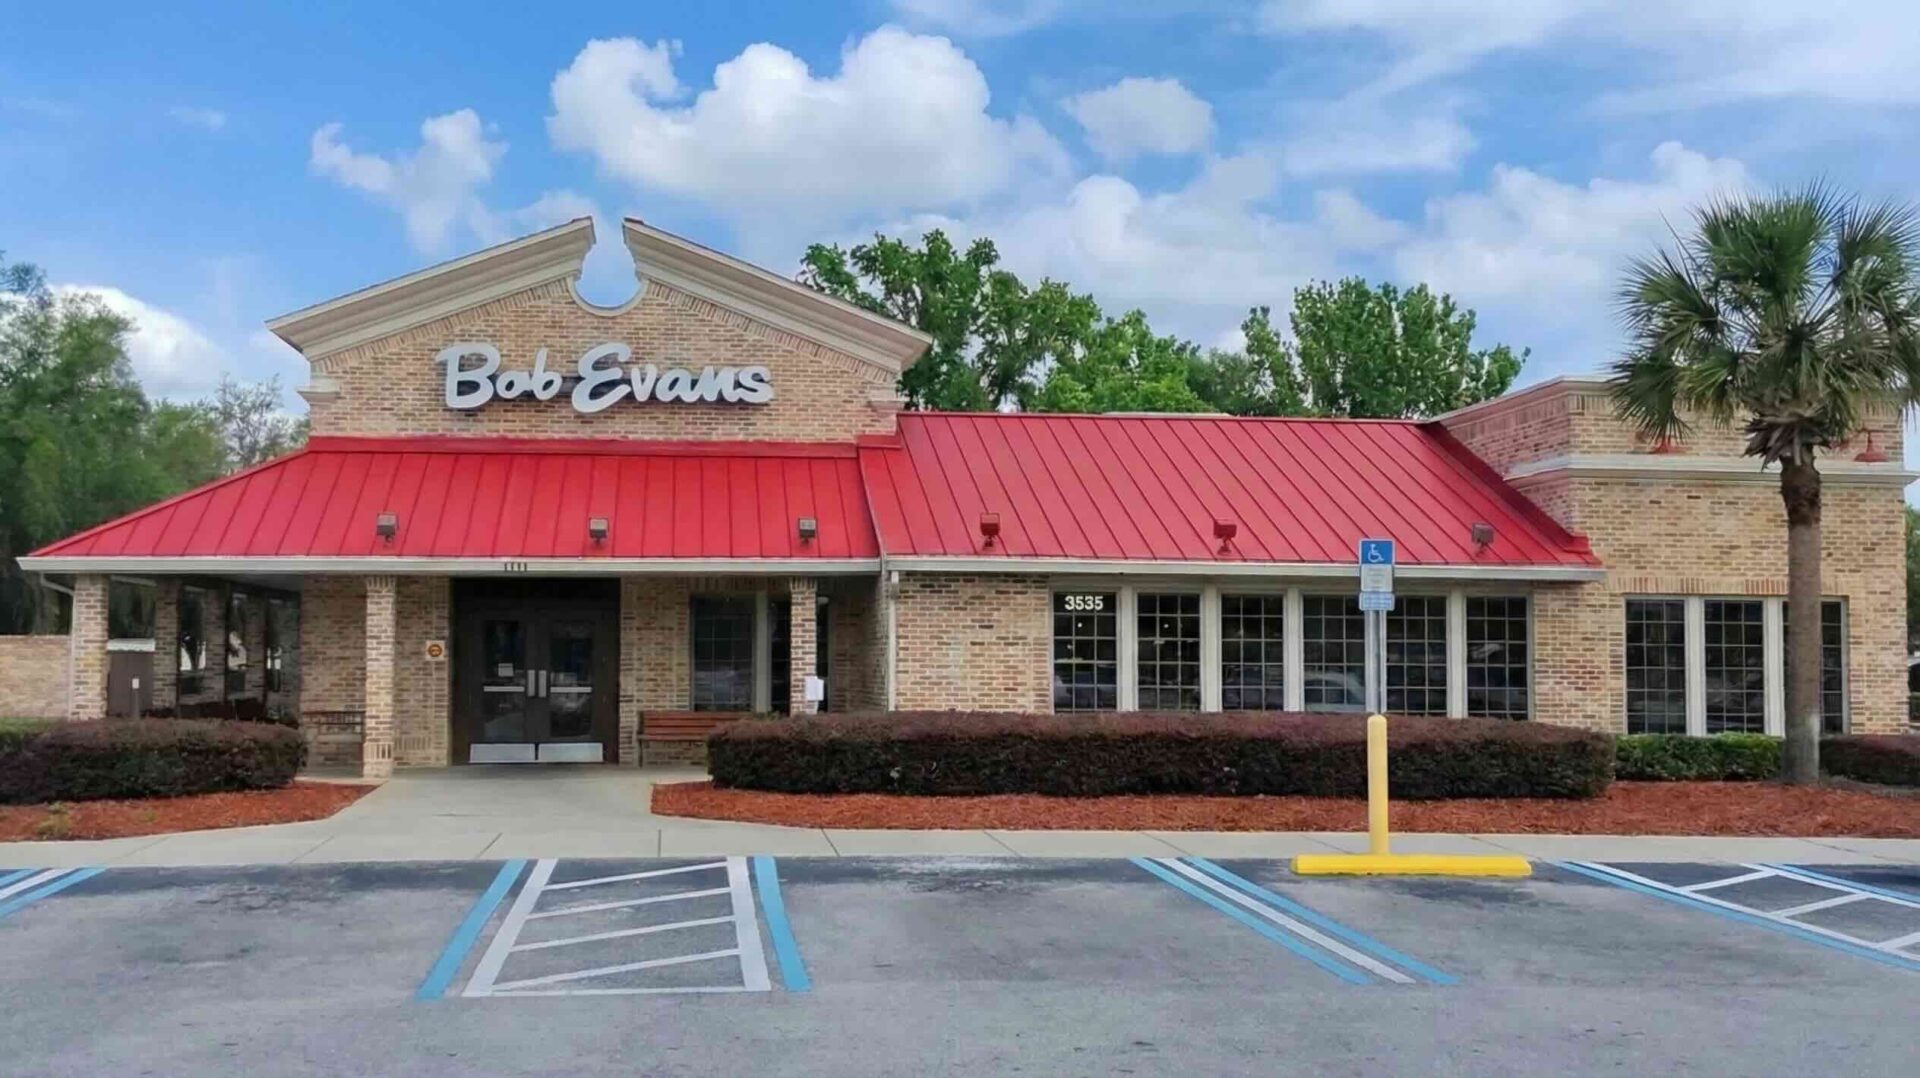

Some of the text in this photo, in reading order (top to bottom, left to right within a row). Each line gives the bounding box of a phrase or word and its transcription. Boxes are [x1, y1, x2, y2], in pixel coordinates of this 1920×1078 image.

[436, 343, 774, 413] Bob Evans
[1065, 595, 1104, 610] 3535
